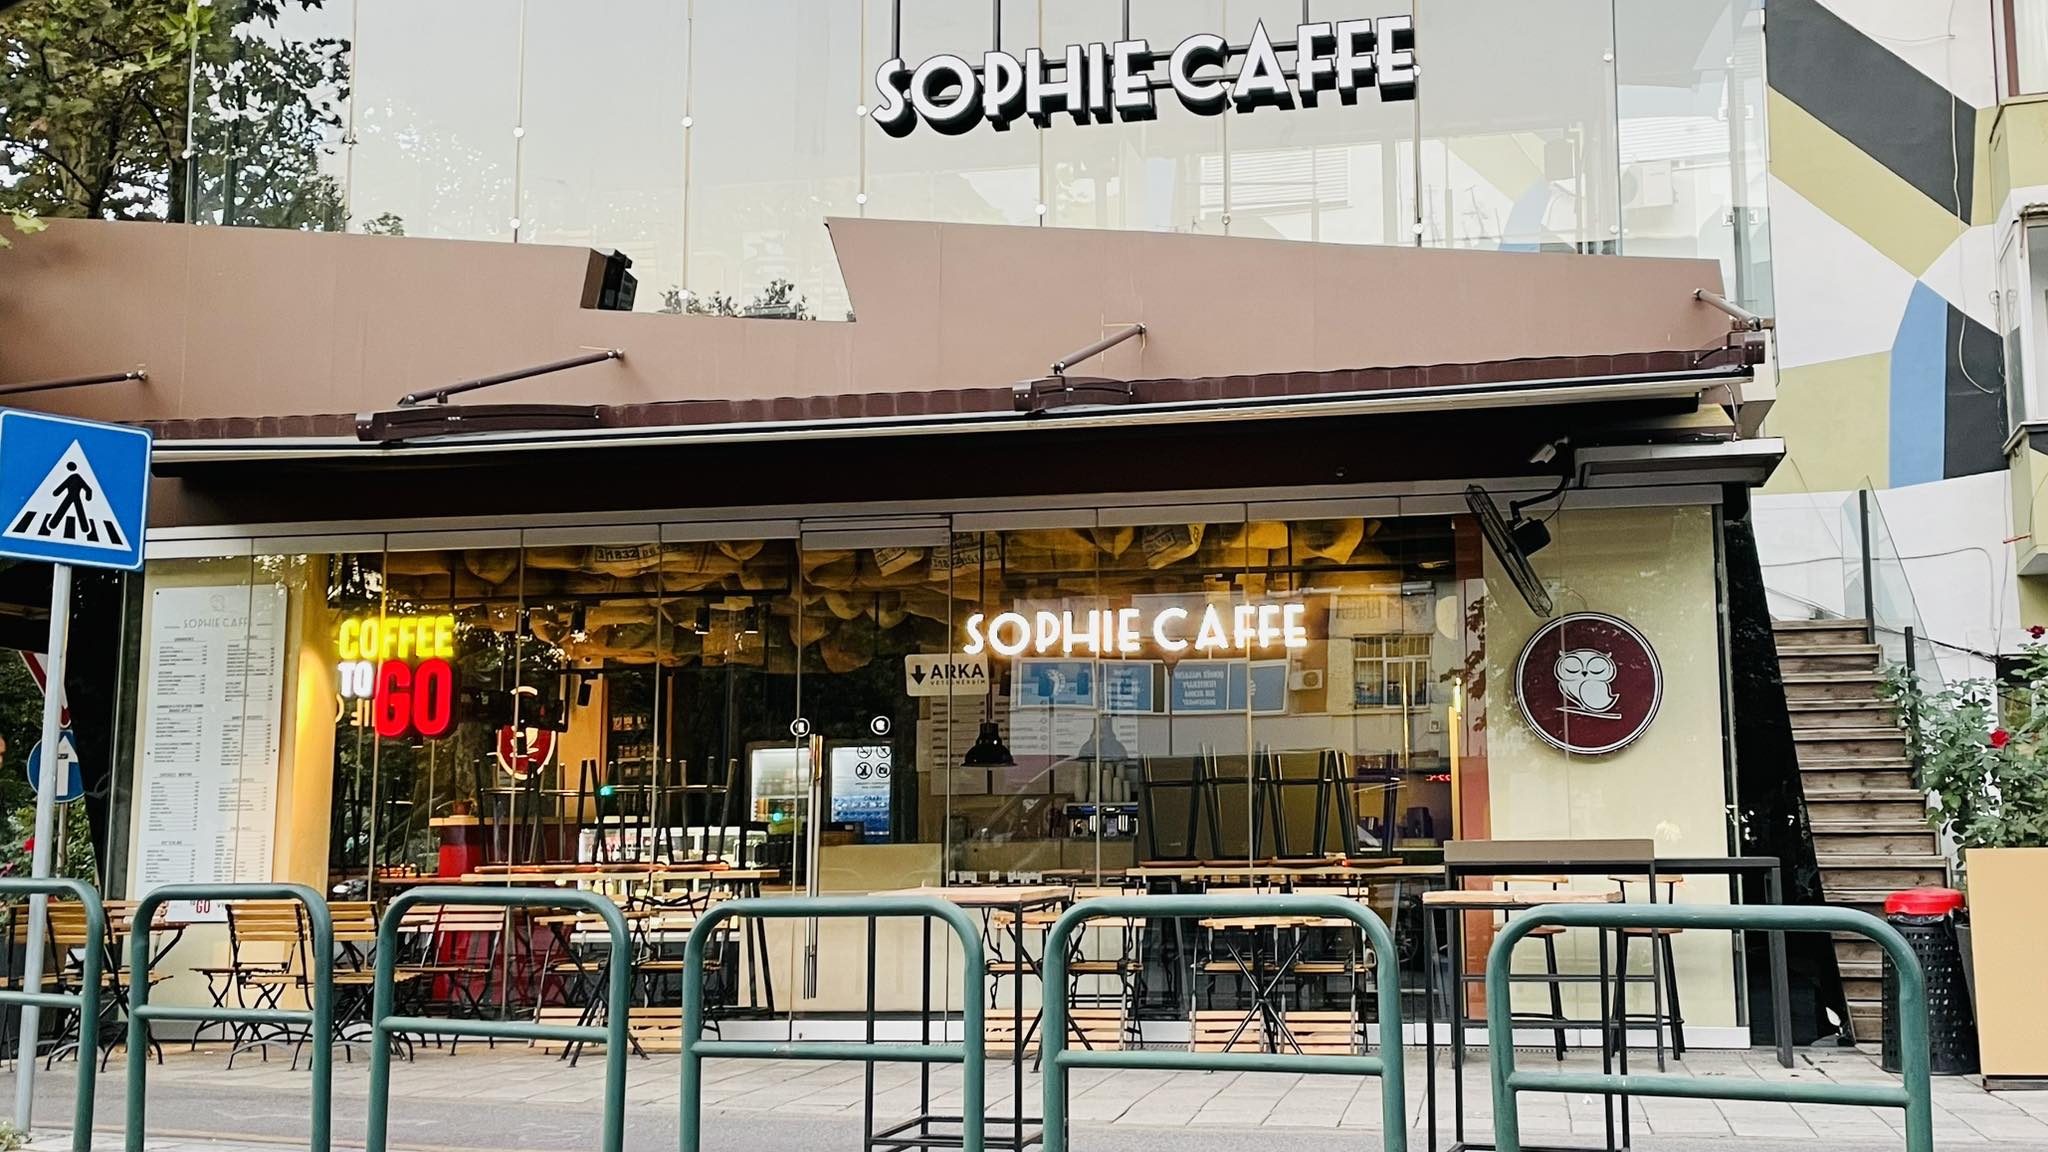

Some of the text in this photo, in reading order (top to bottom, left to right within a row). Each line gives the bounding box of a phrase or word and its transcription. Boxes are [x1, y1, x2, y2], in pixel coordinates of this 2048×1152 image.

[871, 15, 1417, 137] SOPHIE CAFFE
[183, 616, 251, 629] SOPHIE CAFF
[339, 616, 455, 660] COFFEE
[963, 603, 1308, 656] SOPHIE CAFFE
[930, 663, 985, 680] ARKA
[338, 661, 375, 699] TO
[374, 659, 454, 738] GO
